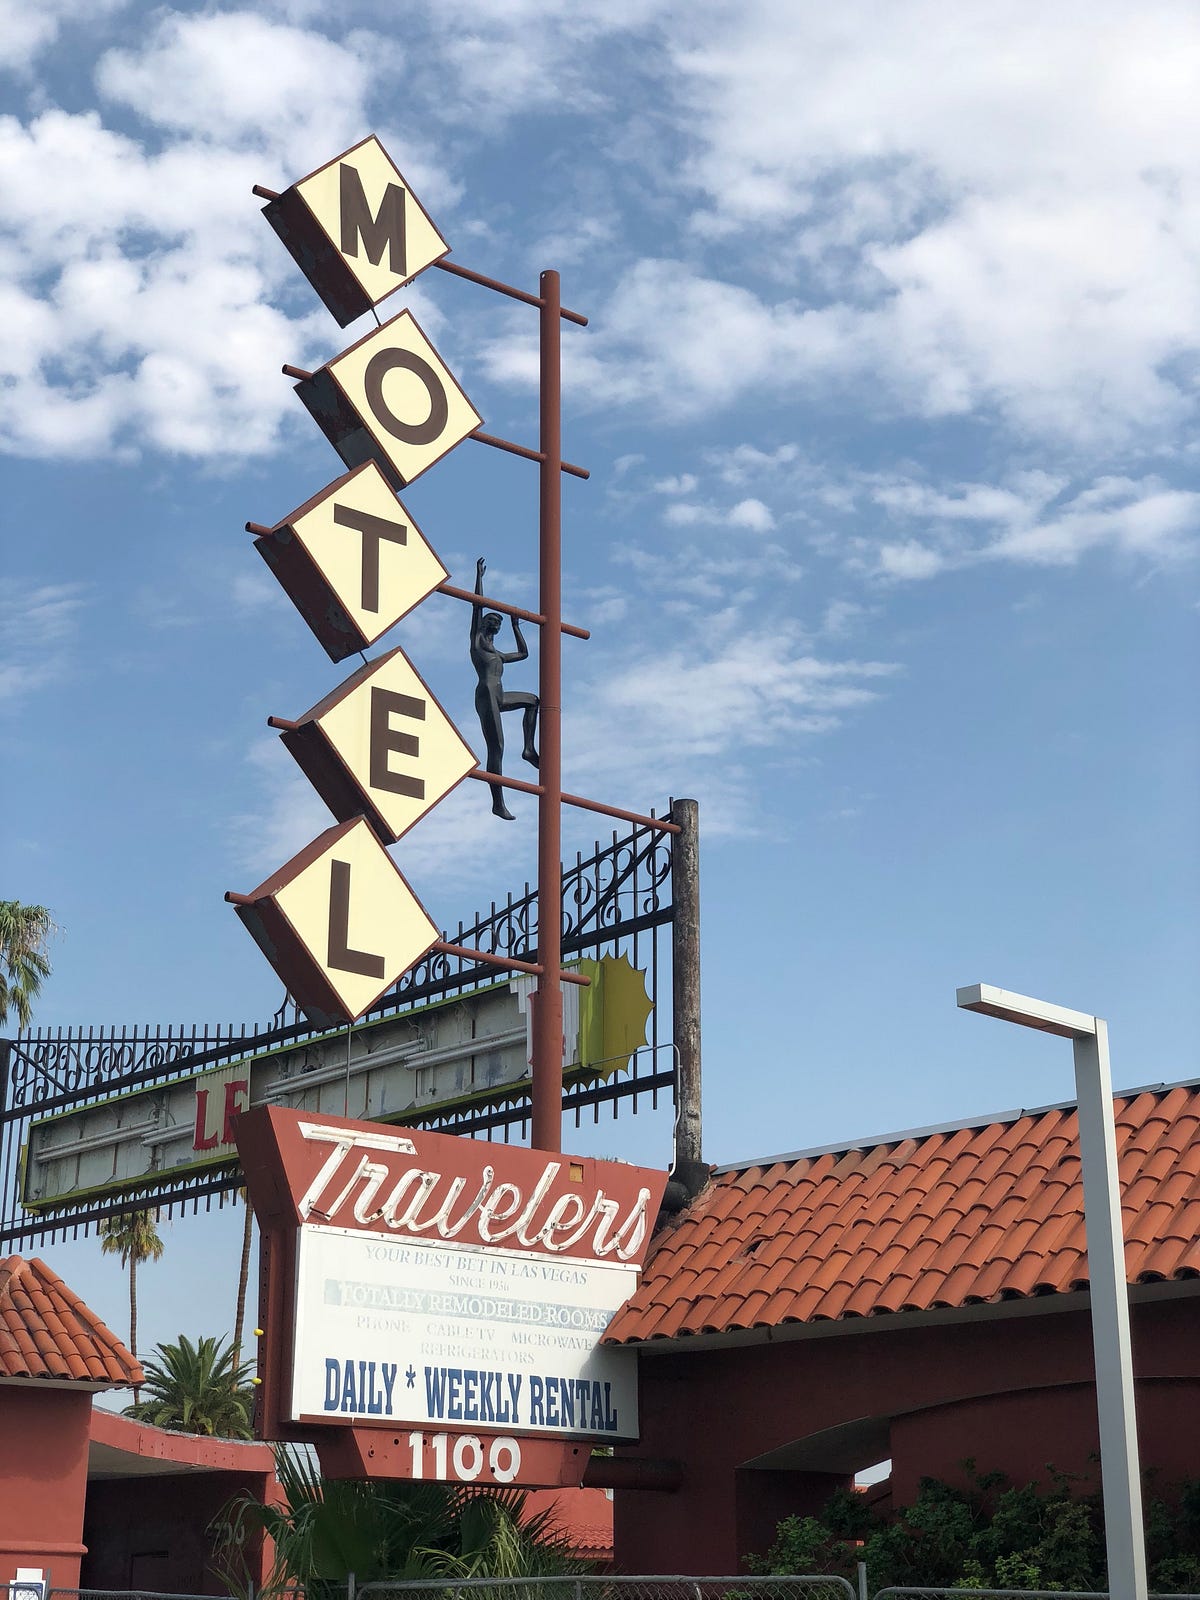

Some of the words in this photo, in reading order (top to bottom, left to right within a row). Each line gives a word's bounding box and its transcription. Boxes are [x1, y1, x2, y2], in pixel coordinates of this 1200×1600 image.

[328, 162, 448, 979] MOTEL
[297, 1121, 651, 1261] Travelers
[365, 1245, 410, 1264] YOUR
[414, 1252, 454, 1268] BEST
[456, 1256, 488, 1272] BET
[490, 1262, 508, 1275] IN
[511, 1264, 538, 1278] LAS
[541, 1267, 588, 1285] VEGAS
[449, 1274, 486, 1288] SINCE
[338, 1281, 428, 1312] TOTALLY
[428, 1294, 543, 1322] REMODELED
[545, 1306, 608, 1330] ROOMS
[356, 1315, 412, 1333] PHONE
[426, 1323, 474, 1338] CABLE
[476, 1328, 496, 1341] TV
[511, 1331, 593, 1351] MICROWAVE
[420, 1342, 536, 1364] REFRIGERATORS
[324, 1358, 397, 1415] DAILY
[424, 1366, 522, 1423] WEEKLY
[530, 1375, 618, 1431] RENTAL
[409, 1431, 521, 1483] 1100
